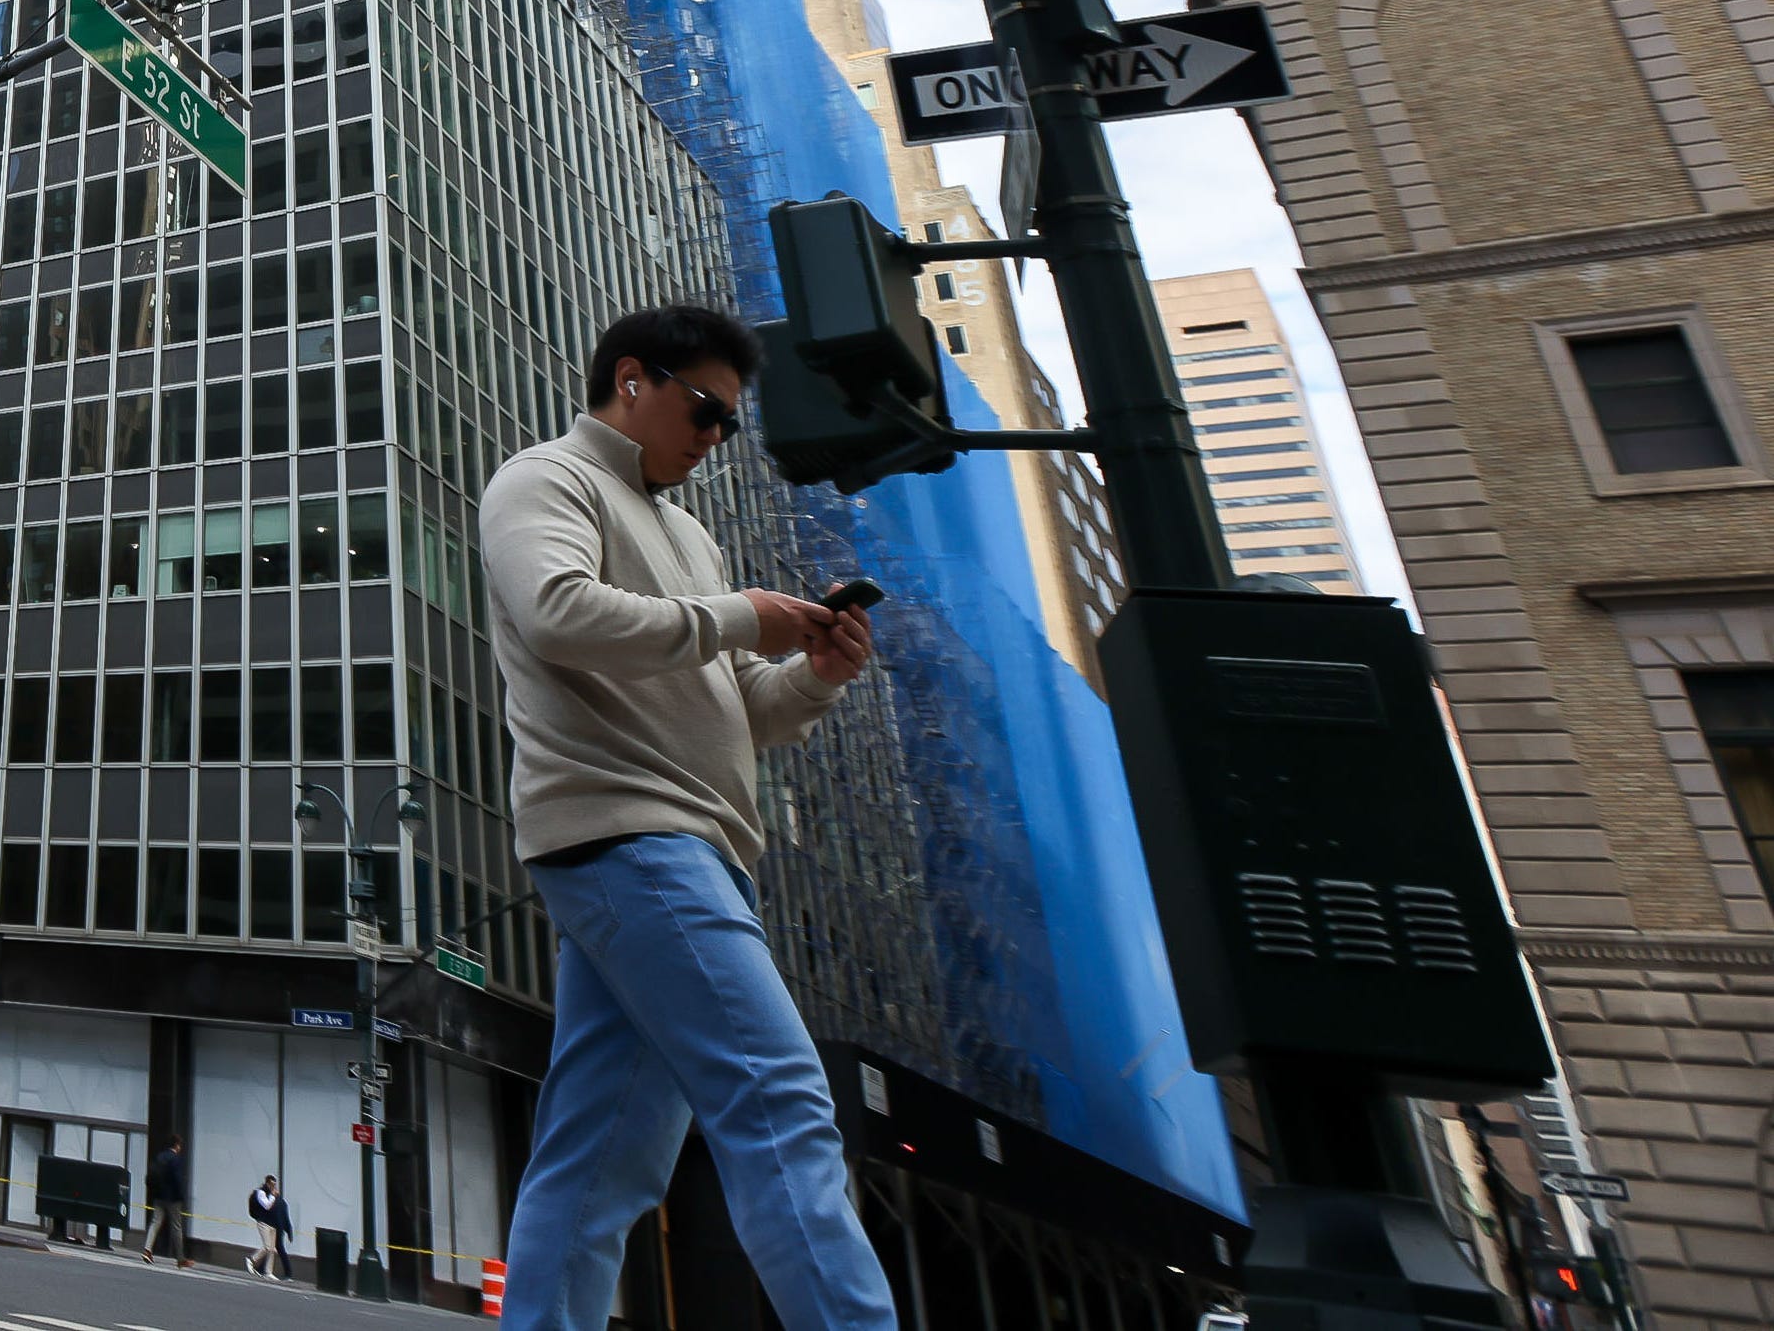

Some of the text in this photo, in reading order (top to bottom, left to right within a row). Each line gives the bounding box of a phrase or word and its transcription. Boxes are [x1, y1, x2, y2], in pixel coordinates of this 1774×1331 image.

[120, 38, 202, 141] E 52 St
[1083, 43, 1193, 91] WAY
[301, 1012, 343, 1026] Park Ave
